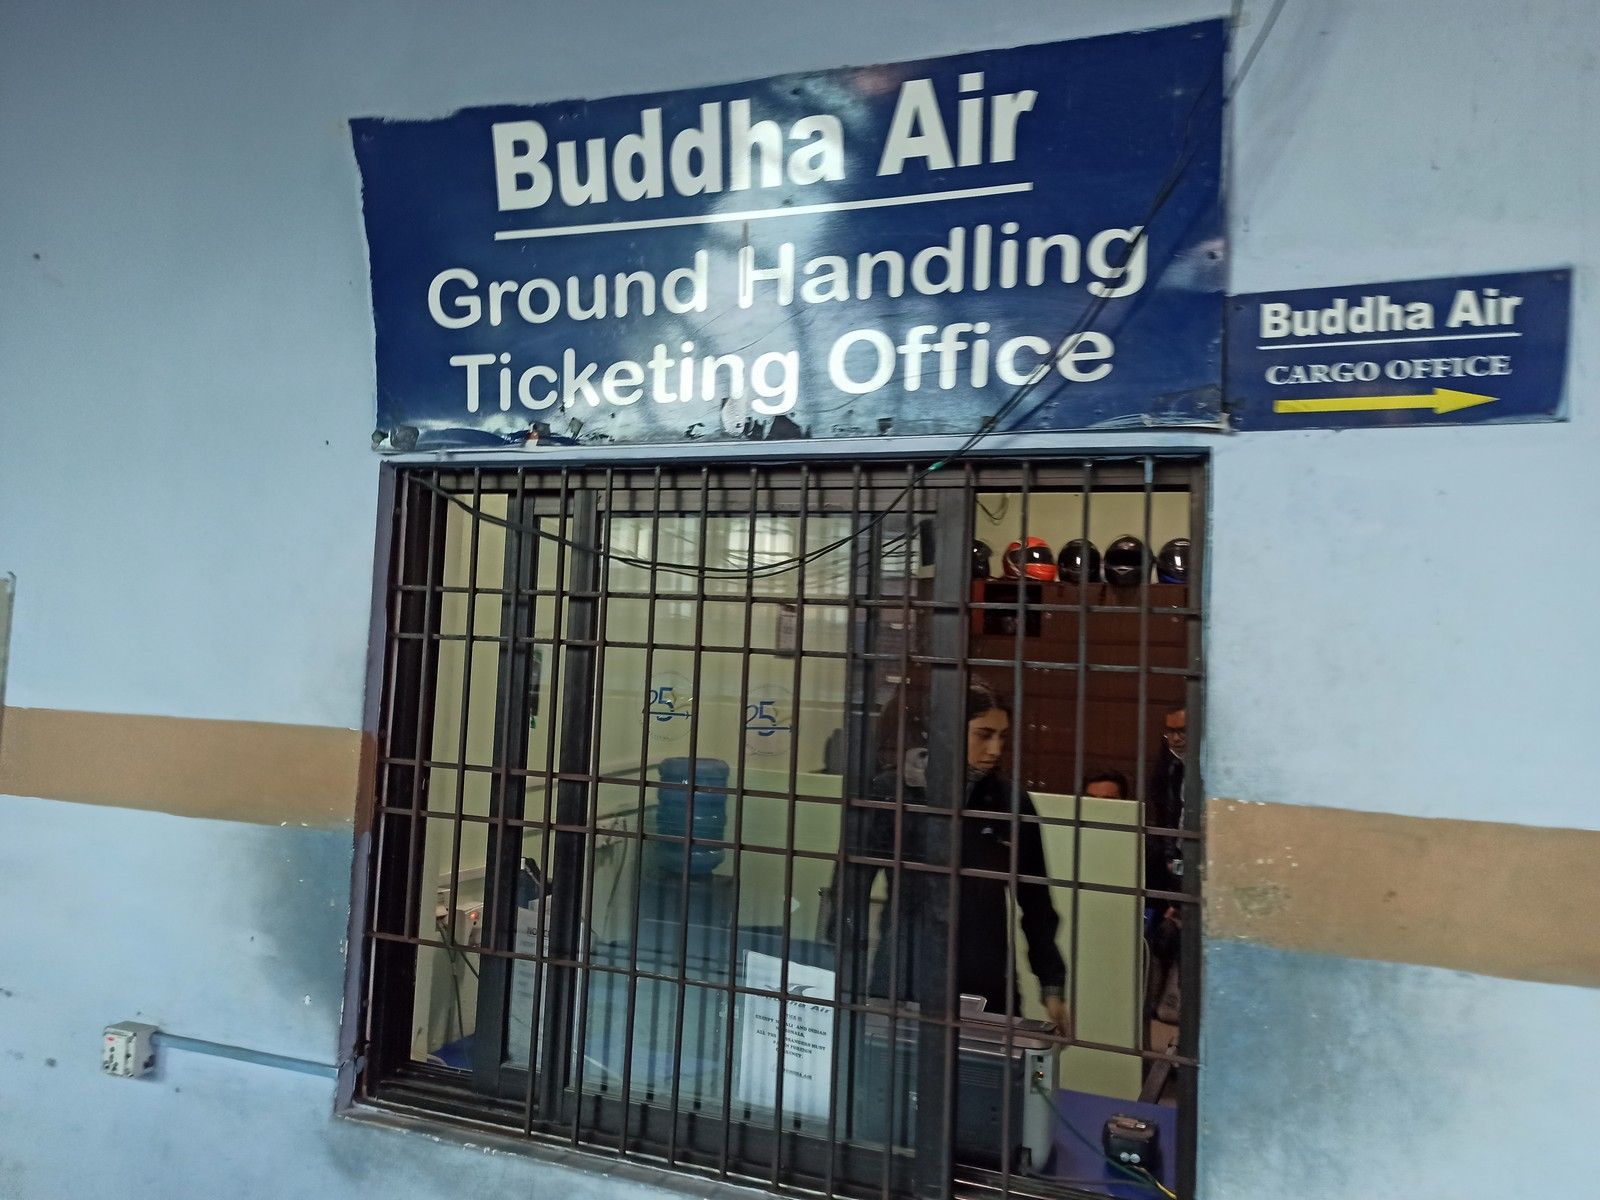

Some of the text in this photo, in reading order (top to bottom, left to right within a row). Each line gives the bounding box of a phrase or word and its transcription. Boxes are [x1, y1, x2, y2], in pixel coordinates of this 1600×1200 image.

[492, 71, 1037, 212] Buddha Air
[427, 221, 1149, 330] Ground Handling
[1259, 287, 1523, 339] Buddha Air
[449, 321, 1115, 415] Ticketing Office
[1265, 355, 1512, 385] CARGO OFFICE
